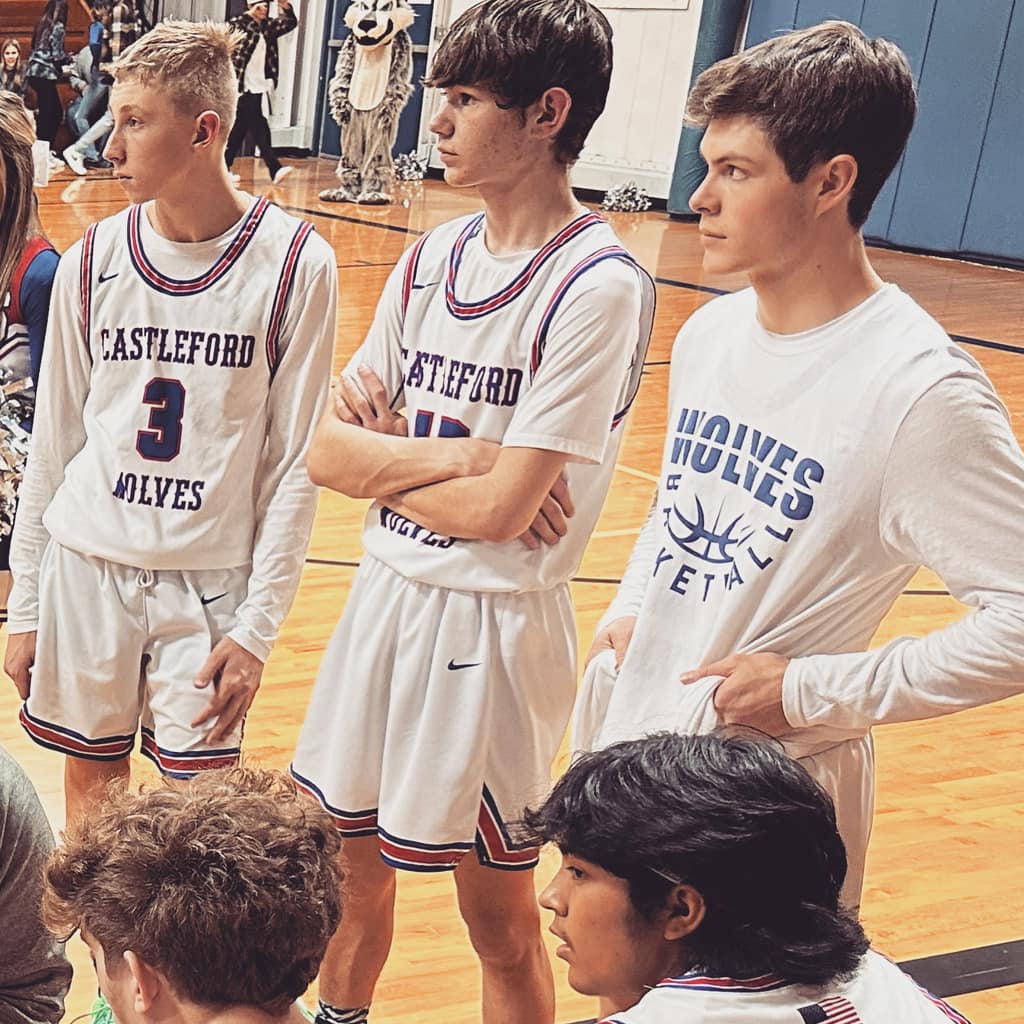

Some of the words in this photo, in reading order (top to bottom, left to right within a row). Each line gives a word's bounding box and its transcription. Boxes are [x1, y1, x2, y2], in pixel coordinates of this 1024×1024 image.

[101, 327, 256, 368] CASTLEFORD
[401, 348, 524, 407] ASTEFORD
[136, 377, 186, 462] 3
